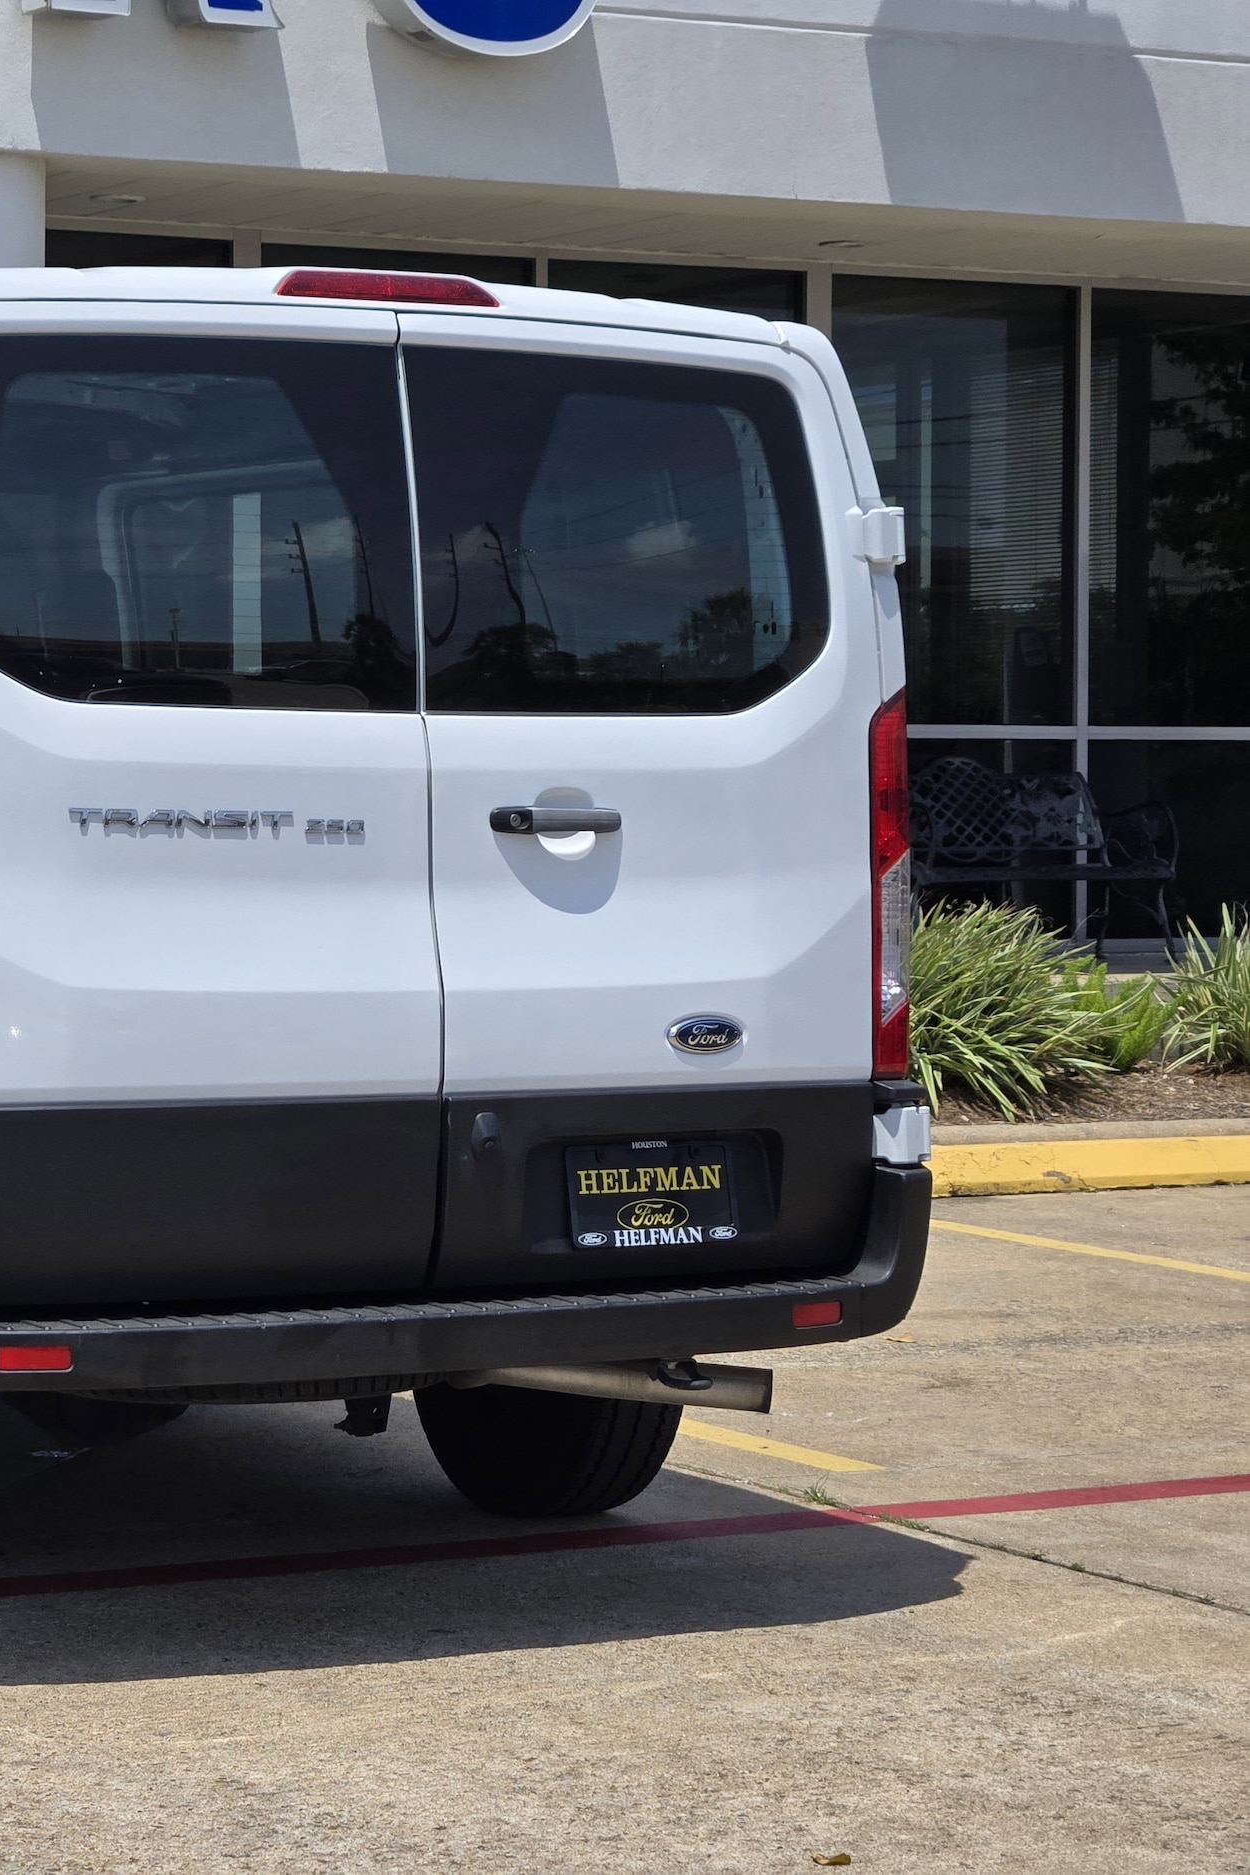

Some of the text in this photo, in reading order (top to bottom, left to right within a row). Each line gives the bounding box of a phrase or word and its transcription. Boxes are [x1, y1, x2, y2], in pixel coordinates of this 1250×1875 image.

[68, 807, 295, 830] TRANSIT
[688, 1023, 730, 1045] Ford
[632, 1140, 668, 1149] HOUSTON
[577, 1164, 722, 1195] HELFMAN
[630, 1203, 675, 1227] Ford
[613, 1226, 704, 1248] HELFMAN
